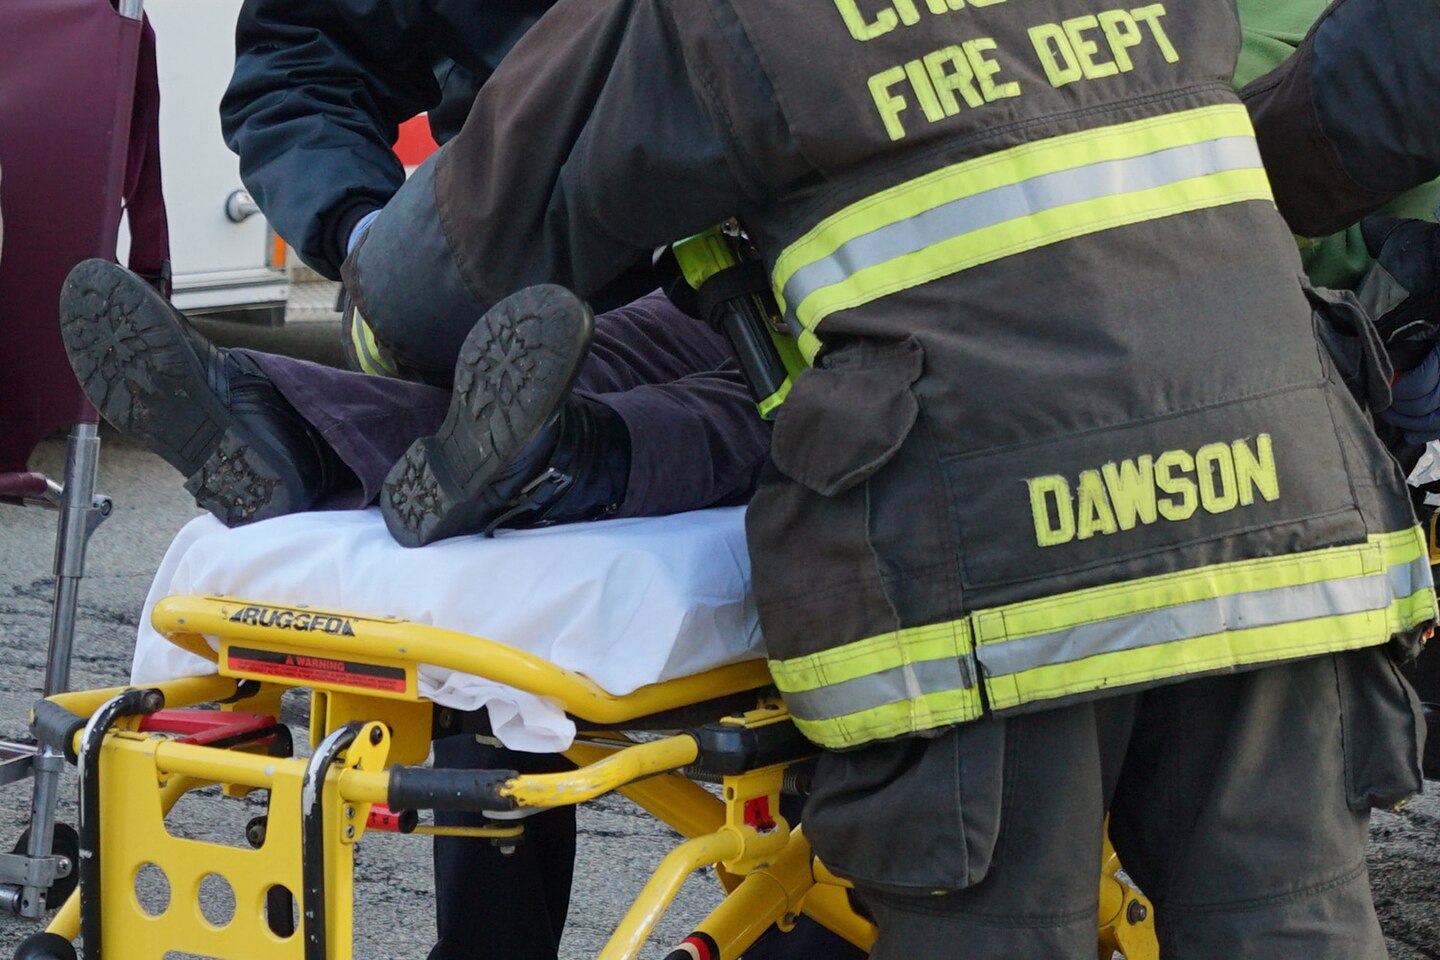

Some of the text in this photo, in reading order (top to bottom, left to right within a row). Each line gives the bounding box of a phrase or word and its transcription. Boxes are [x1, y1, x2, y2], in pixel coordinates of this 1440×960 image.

[867, 3, 1180, 141] FIRE DEPT
[1028, 433, 1280, 547] DAWSON
[241, 607, 342, 634] RUGGED
[297, 655, 346, 672] WARNING
